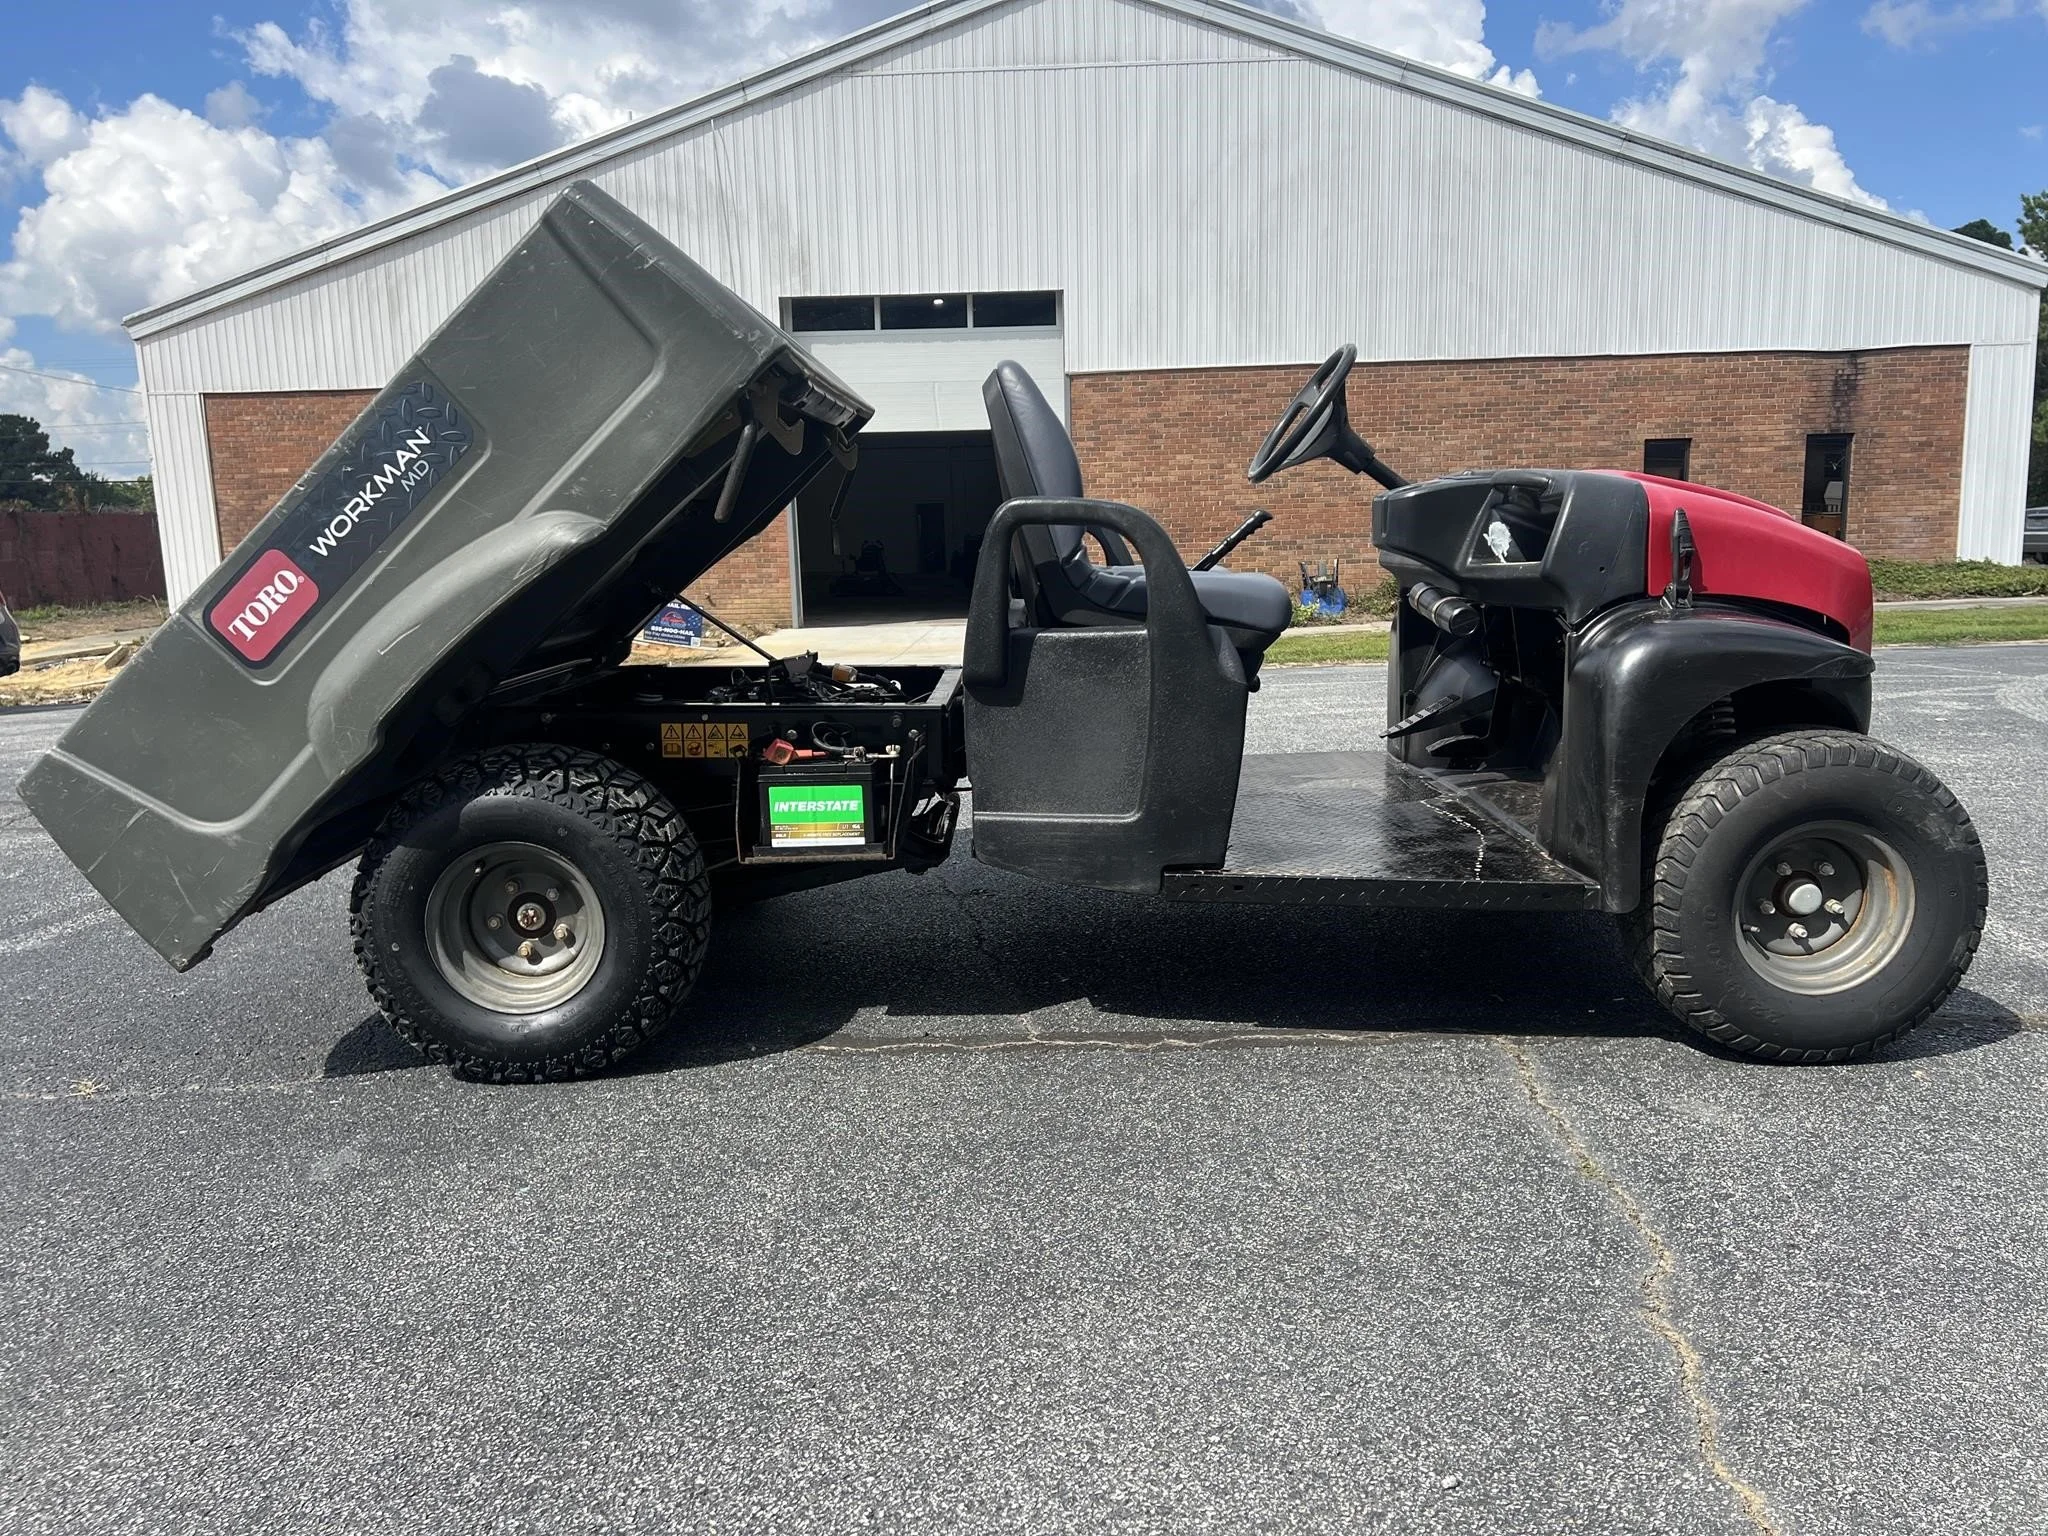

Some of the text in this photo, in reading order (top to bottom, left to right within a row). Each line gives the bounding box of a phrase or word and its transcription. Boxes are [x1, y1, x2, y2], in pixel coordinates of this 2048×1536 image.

[309, 427, 431, 557] WORKMAN
[400, 459, 430, 492] MD
[228, 569, 300, 642] TORO
[774, 800, 859, 813] INTERSTATE
